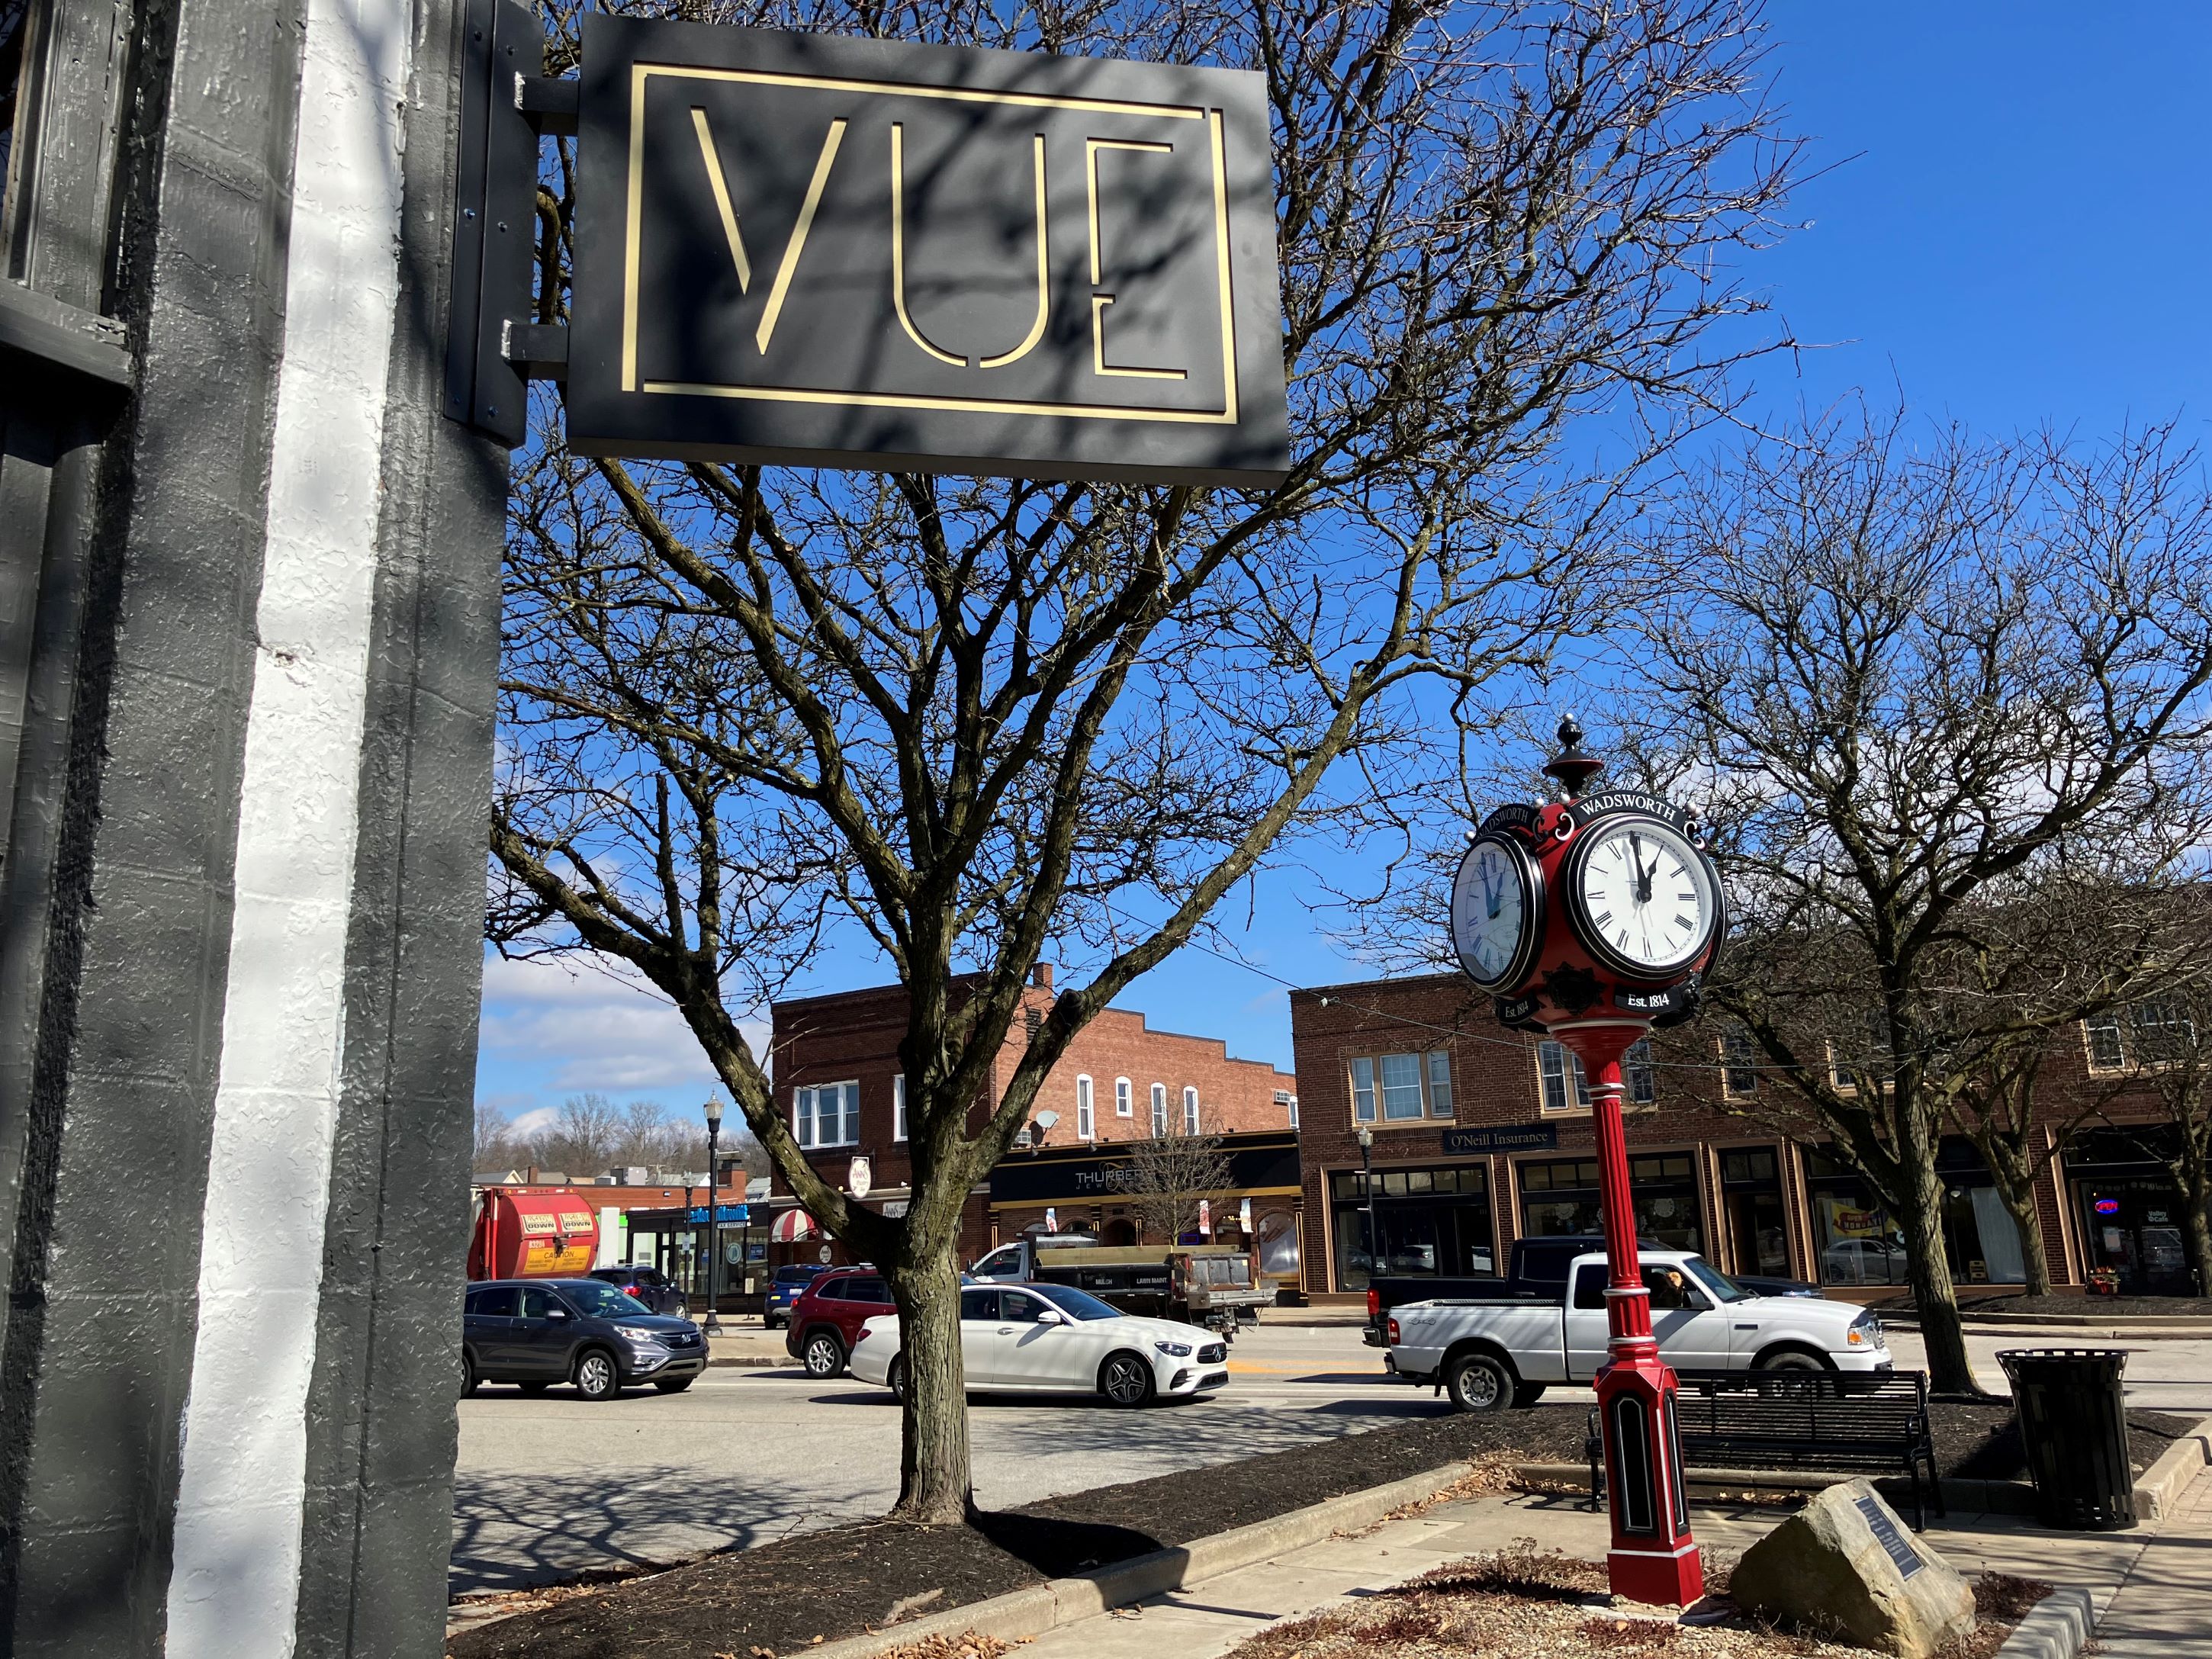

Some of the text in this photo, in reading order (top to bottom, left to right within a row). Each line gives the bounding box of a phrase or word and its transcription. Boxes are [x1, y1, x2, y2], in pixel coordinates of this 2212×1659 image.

[690, 106, 1188, 379] VUE
[1580, 794, 1677, 821] WADSWORTH
[1628, 993, 1670, 1007] Est. 1814
[1517, 1001, 1529, 1015] 1814
[1451, 1133, 1548, 1147] O'Neill Insurance
